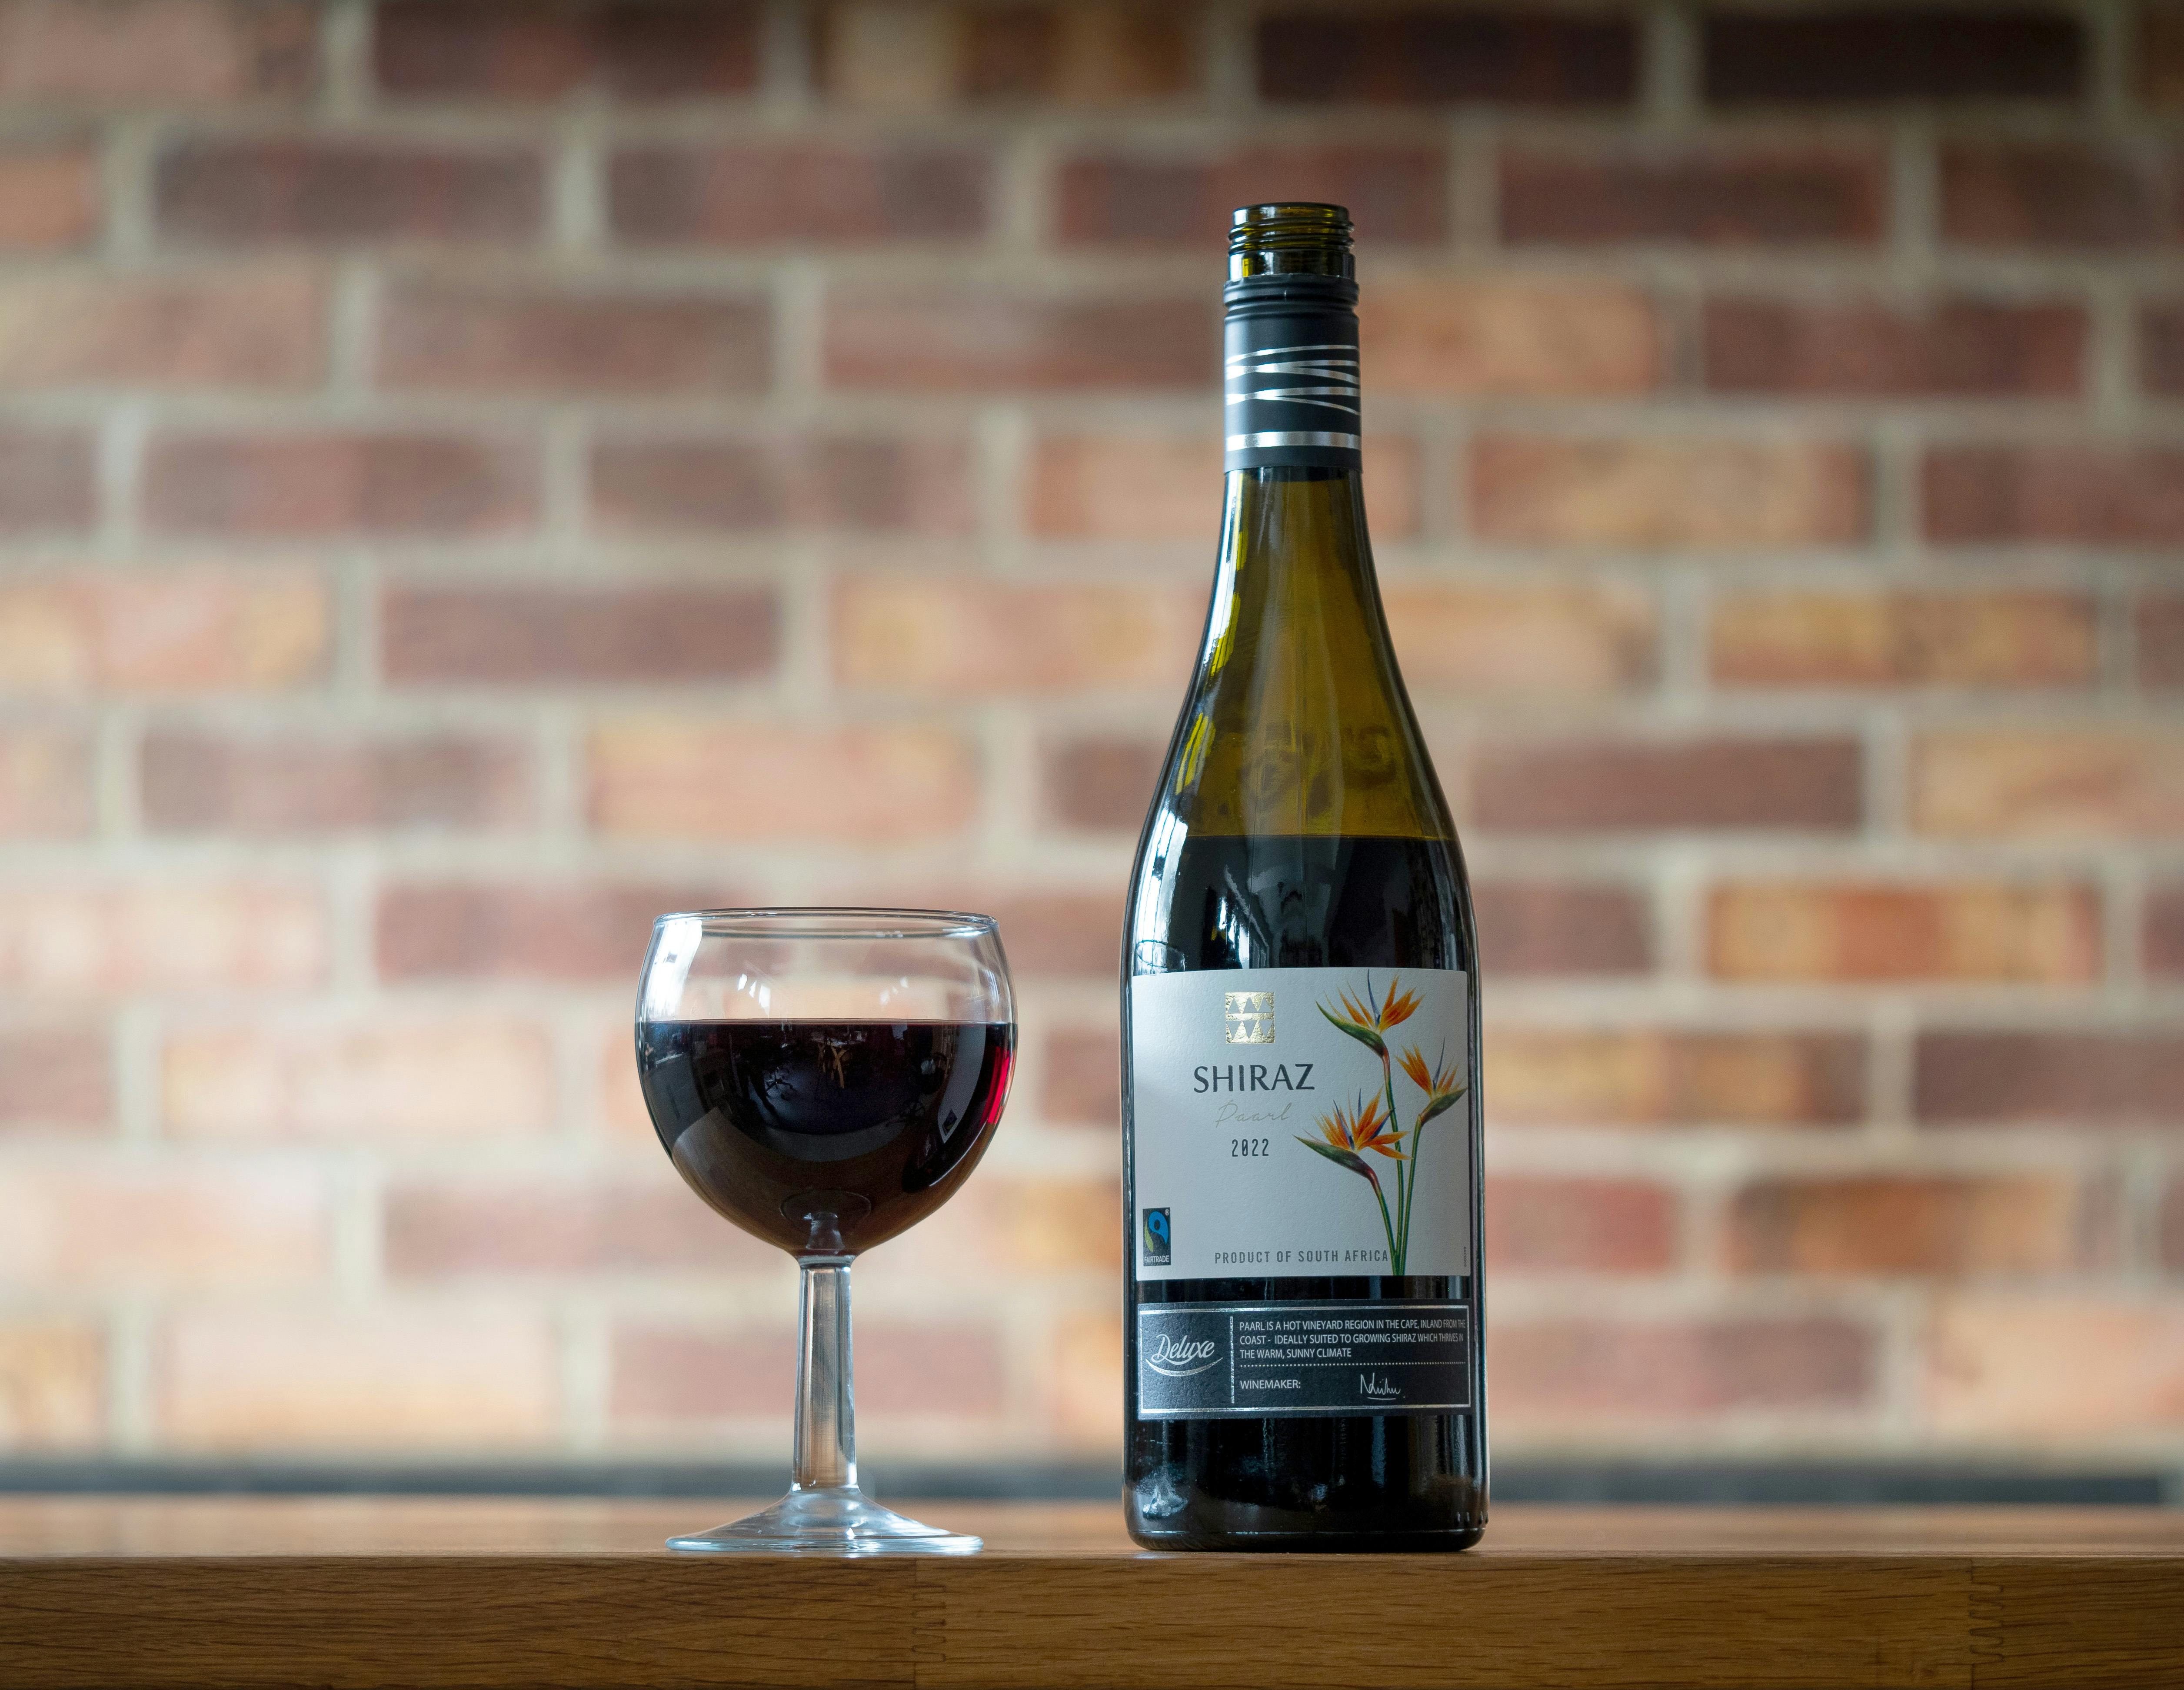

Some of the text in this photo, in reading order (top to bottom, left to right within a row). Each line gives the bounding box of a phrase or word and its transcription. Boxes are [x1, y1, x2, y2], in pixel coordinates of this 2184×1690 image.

[1194, 1063, 1315, 1093] SHIRAZ
[1215, 1100, 1292, 1128] Paarl
[1232, 1138, 1269, 1157] 2022
[1215, 1250, 1388, 1264] PRODUCT OF SOUTH AFRICA
[1240, 1321, 1265, 1331] PAARL
[1267, 1321, 1273, 1330] IS
[1275, 1321, 1281, 1330] A
[1284, 1321, 1301, 1330] HOT
[1302, 1321, 1343, 1330] VINEYARD
[1345, 1320, 1374, 1329] REGION
[1377, 1320, 1384, 1328] IN
[1385, 1320, 1399, 1328] THE
[1401, 1320, 1419, 1330] CAPE,
[1421, 1320, 1442, 1328] INLAND
[1443, 1319, 1457, 1328] FROM
[1240, 1336, 1266, 1345] COAST
[1275, 1335, 1308, 1344] IDEALLY
[1310, 1334, 1338, 1344] SUITED
[1340, 1334, 1351, 1343] TO
[1353, 1334, 1390, 1343] GROWING
[1392, 1333, 1416, 1342] SHIRAZ
[1418, 1333, 1438, 1342] WHICH
[1438, 1333, 1458, 1342] THRIVES
[1151, 1334, 1215, 1365] Deluxe
[1240, 1348, 1352, 1359] THE WARM, SUNNY CLIMATE
[1240, 1380, 1301, 1389] WINEMAKER:
